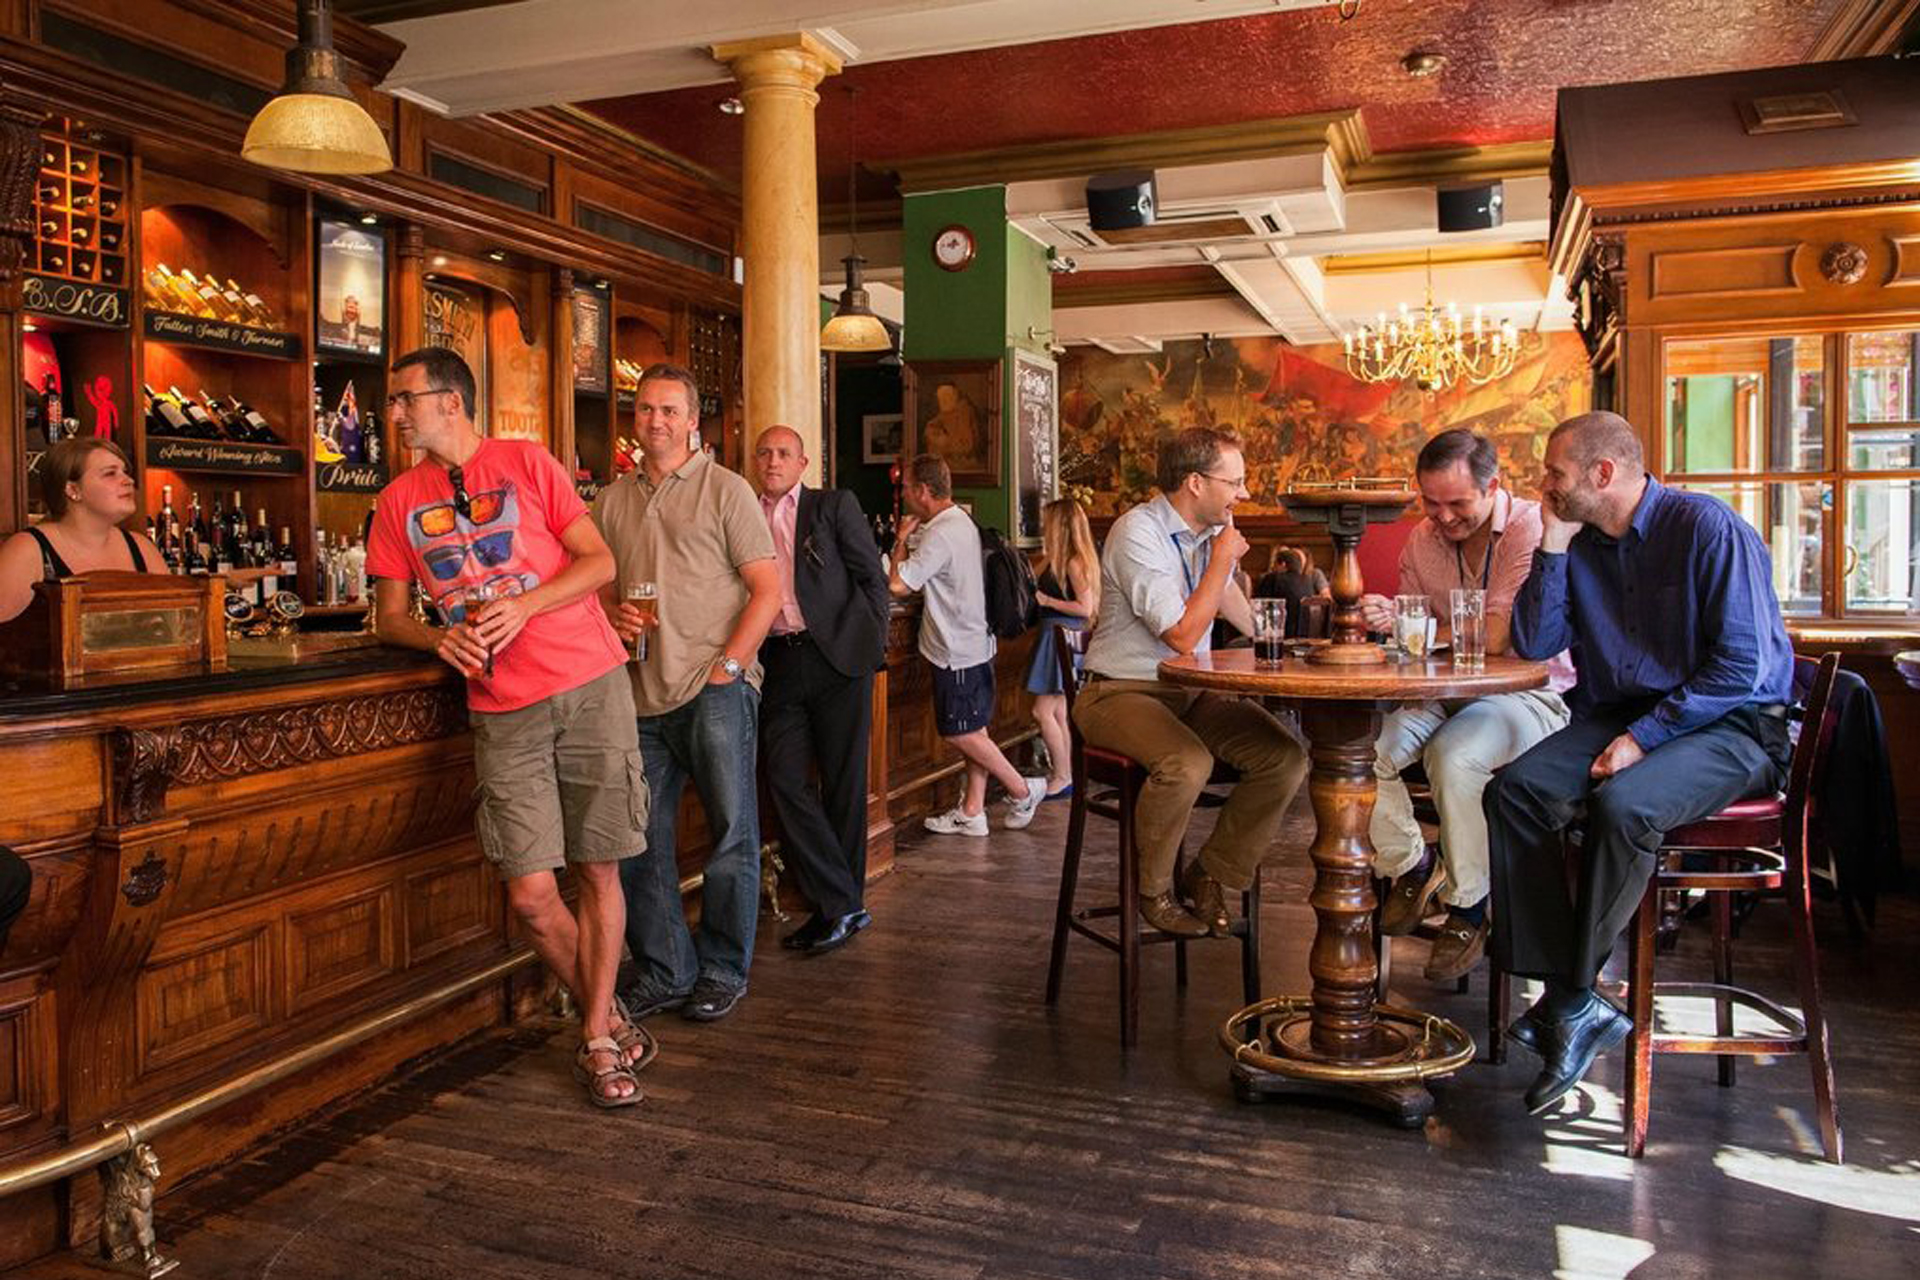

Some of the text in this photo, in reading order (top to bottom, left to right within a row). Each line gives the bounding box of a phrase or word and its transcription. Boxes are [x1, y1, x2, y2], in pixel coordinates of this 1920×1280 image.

[195, 322, 229, 340] Smith
[159, 443, 204, 460] Award
[205, 447, 251, 465] Winning
[319, 464, 383, 489] Pride
